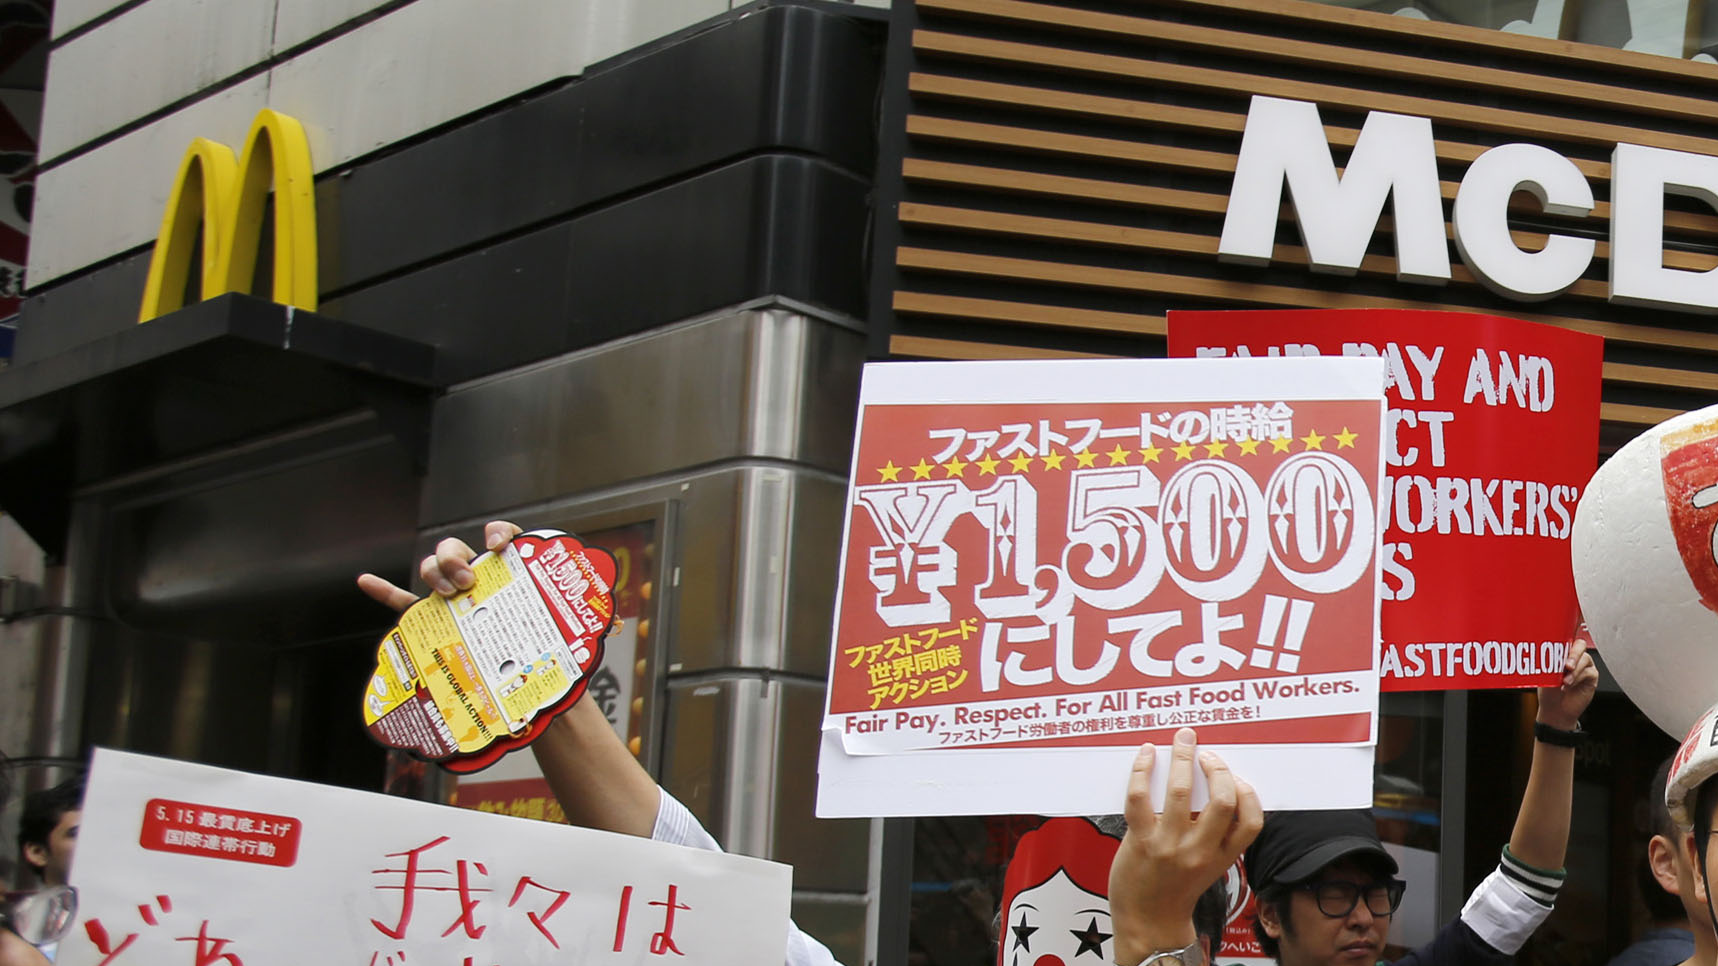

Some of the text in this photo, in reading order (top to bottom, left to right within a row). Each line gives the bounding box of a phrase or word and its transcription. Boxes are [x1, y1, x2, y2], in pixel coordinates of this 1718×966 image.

[1464, 349, 1554, 412] AND
[929, 402, 1293, 464] ファストフードの時給
[855, 450, 1376, 627] ¥1,500
[845, 617, 979, 667] ファストフード
[867, 644, 962, 686] 世界同時
[981, 593, 1315, 692] にしてよ!!
[1381, 641, 1568, 677] ASTFOODGLOB
[431, 649, 446, 667] THIS
[446, 672, 470, 705] GLOBAL
[845, 677, 1360, 736] Fair Pay. Respect. For All Fast Food Workers.
[868, 670, 969, 709] アクション
[371, 835, 692, 956] 我々は
